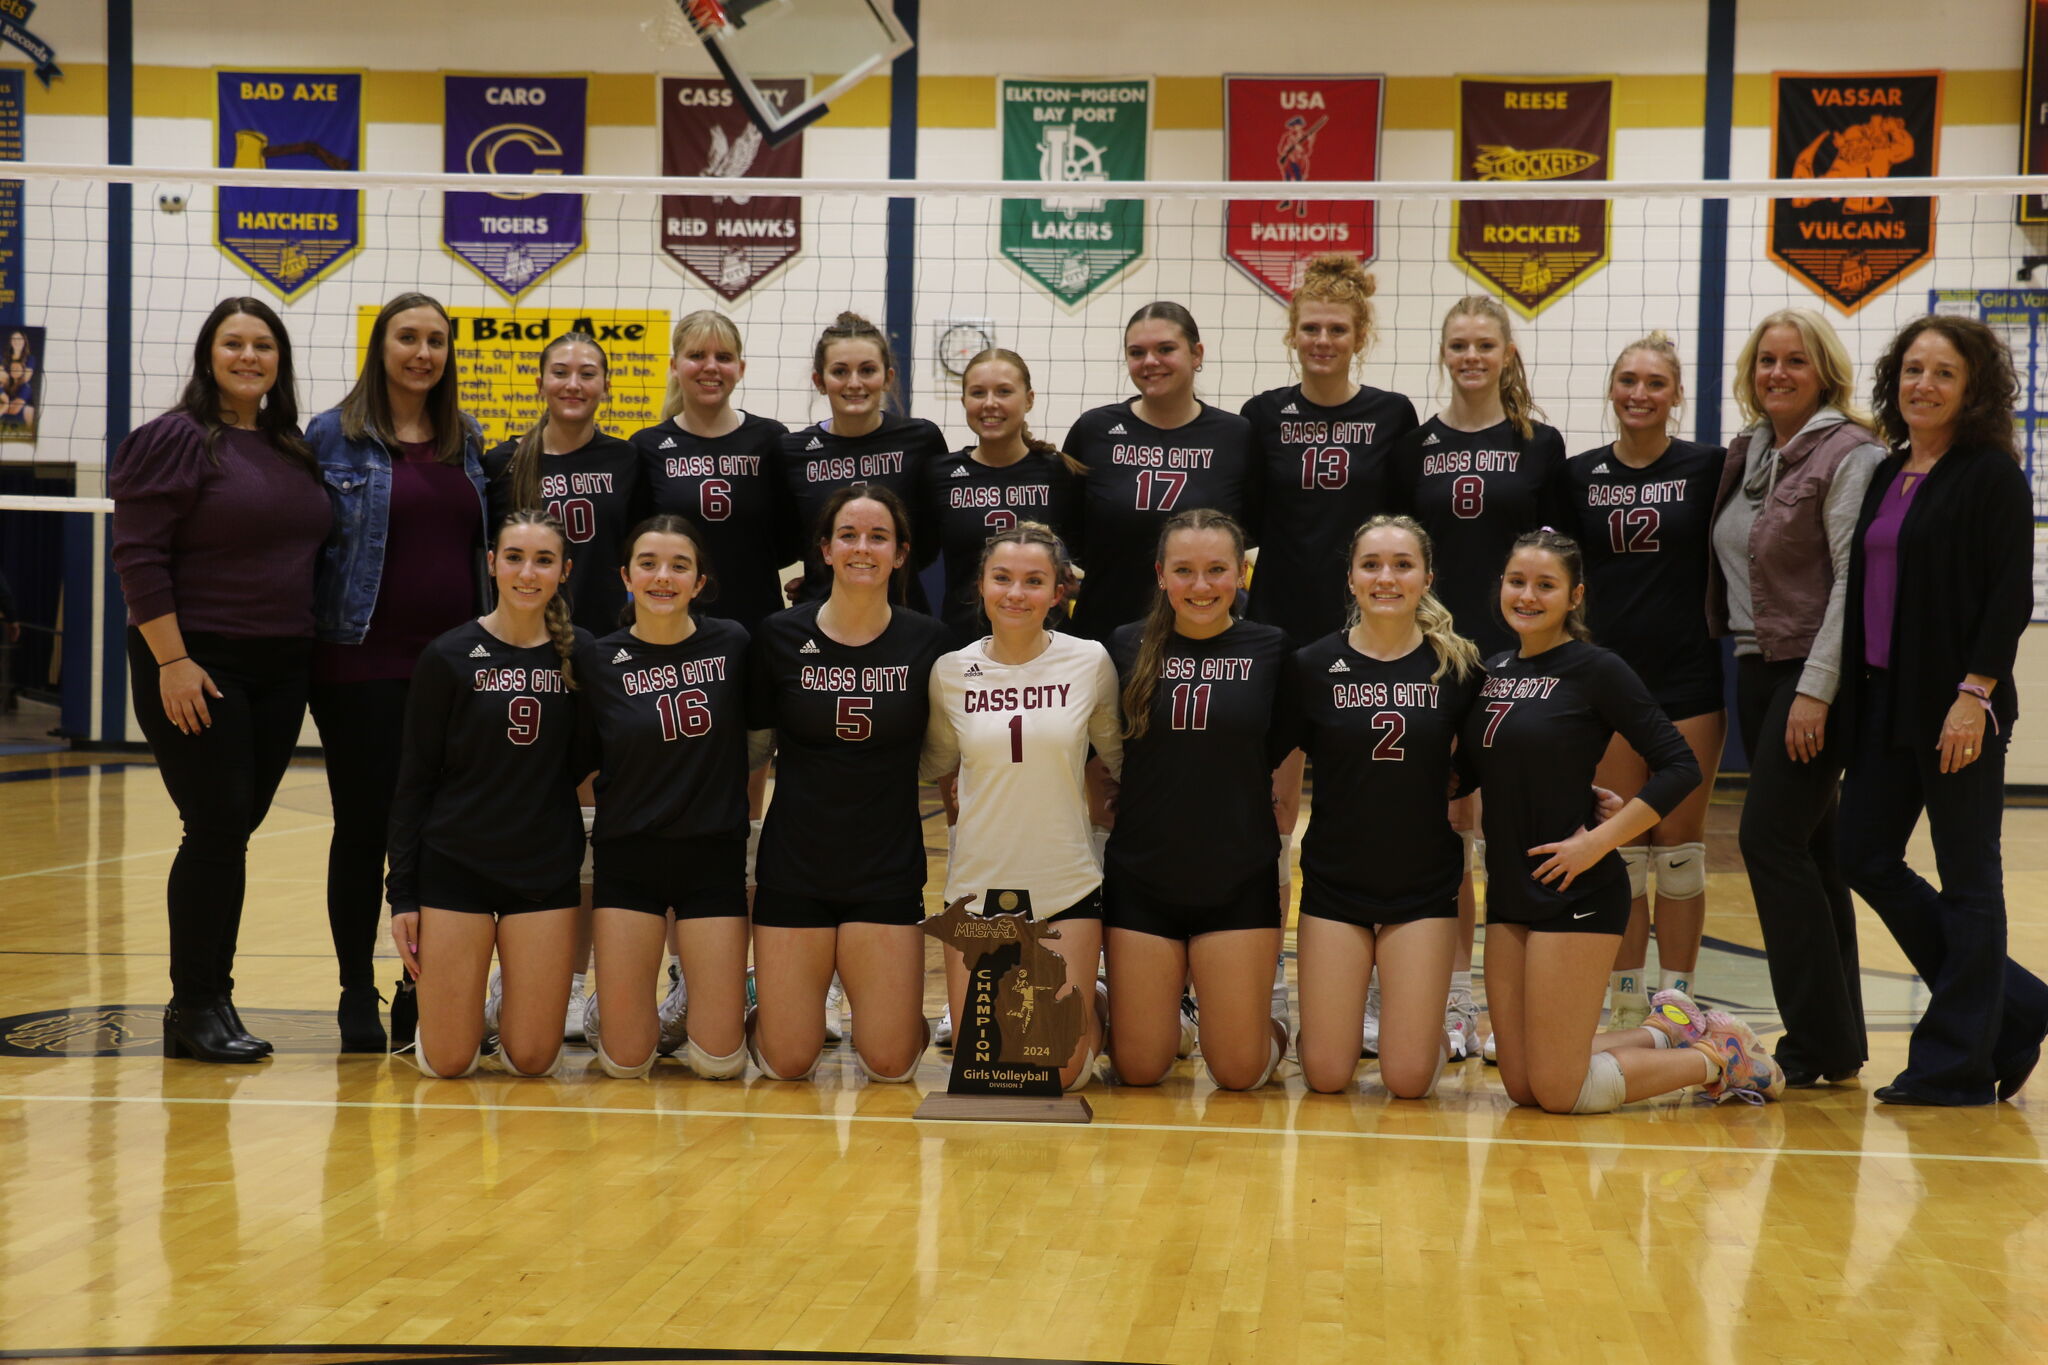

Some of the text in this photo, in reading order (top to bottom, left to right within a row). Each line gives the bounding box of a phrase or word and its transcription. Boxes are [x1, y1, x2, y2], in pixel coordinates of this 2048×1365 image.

[3, 24, 48, 62] Records
[241, 83, 338, 101] BAD AXE
[485, 87, 546, 106] CARO
[679, 88, 733, 107] CASS
[1005, 87, 1146, 103] ELKTON-PIGEON
[1280, 91, 1325, 110] USA
[1504, 91, 1568, 110] REESE
[1811, 88, 1903, 106] VASSAR
[1033, 107, 1117, 122] BAY PORT
[237, 212, 339, 231] HATCHETS
[480, 216, 549, 235] TIGERS
[667, 218, 796, 238] RED HAWKS
[1031, 221, 1113, 241] LAKERS
[1250, 223, 1349, 242] PATRIOTS
[1798, 221, 1906, 240] VULCANS
[1483, 225, 1581, 243] ROCKETS
[473, 317, 549, 341] Bad
[571, 317, 644, 341] Axe
[620, 393, 650, 404] lose
[600, 408, 657, 419] choose.
[1280, 422, 1376, 444] CASS CITY
[665, 455, 760, 478] CASS CITY
[806, 451, 904, 482] CASS CITY
[1112, 444, 1213, 469] CASS CITY
[1301, 447, 1350, 490] 13
[1423, 450, 1520, 476] CASS CITY
[541, 473, 613, 498] SS CITY
[950, 485, 1050, 508] CASS CITY
[1135, 470, 1187, 511] 17
[1453, 475, 1484, 519] 8
[1588, 479, 1687, 507] CASS CITY
[700, 478, 732, 522] 6
[1608, 507, 1660, 553] 12
[473, 668, 568, 693] CASS CIT
[622, 656, 726, 696] CASS CITY
[801, 665, 909, 692] CASS CITY
[963, 669, 984, 678] adidas
[1160, 657, 1253, 681] SS CITY
[964, 683, 1071, 714] CASS CITY
[1333, 683, 1440, 709] CASS CITY
[1512, 676, 1560, 700] CITY
[656, 688, 712, 742] 16
[1171, 683, 1212, 730] 11
[507, 696, 541, 746] 9
[836, 696, 873, 742] 5
[1482, 701, 1514, 748] 7
[1008, 715, 1023, 763] 1
[1371, 711, 1406, 761] 2
[975, 969, 991, 1062] CHAMPION
[1023, 1046, 1050, 1056] 2024
[963, 1069, 1049, 1083] Girls Volleyball
